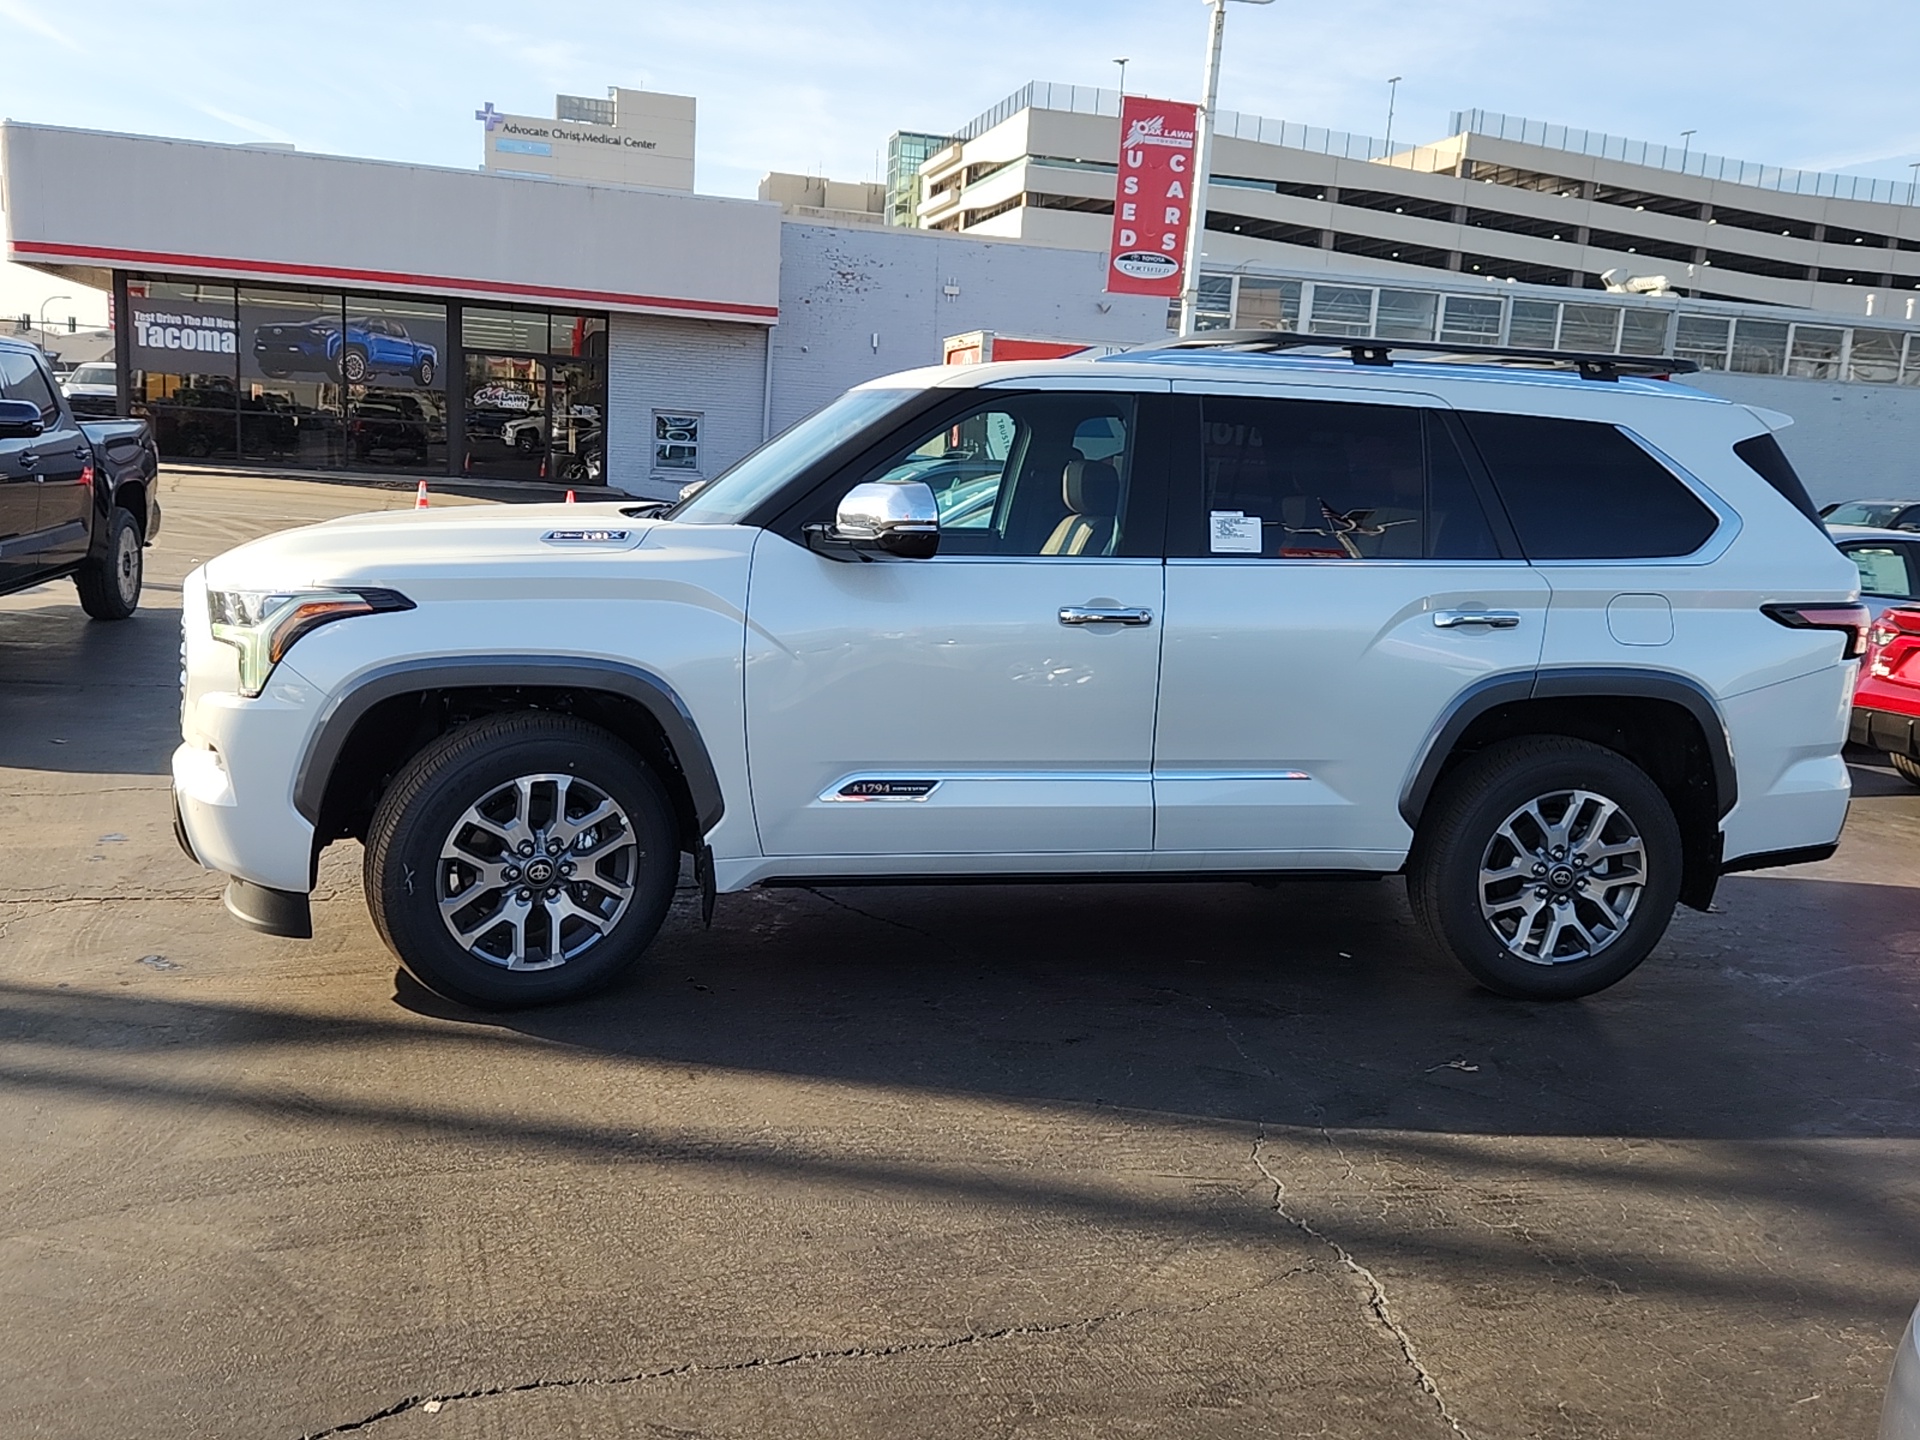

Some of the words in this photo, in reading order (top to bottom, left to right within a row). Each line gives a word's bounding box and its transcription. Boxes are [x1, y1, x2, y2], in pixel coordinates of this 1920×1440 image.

[502, 124, 549, 138] Advocate
[552, 128, 580, 142] Christ
[582, 132, 622, 146] Medical
[624, 137, 657, 150] Center
[1163, 129, 1194, 140] LAWN
[1119, 149, 1143, 247] USED
[1161, 154, 1186, 251] CARS
[1141, 255, 1166, 263] TOYOTA
[133, 310, 156, 323] Test
[156, 312, 182, 325] Drive
[182, 314, 201, 326] The
[202, 316, 216, 327] All
[216, 317, 242, 329] New
[133, 321, 242, 354] Tacoma
[861, 783, 891, 793] 1794
